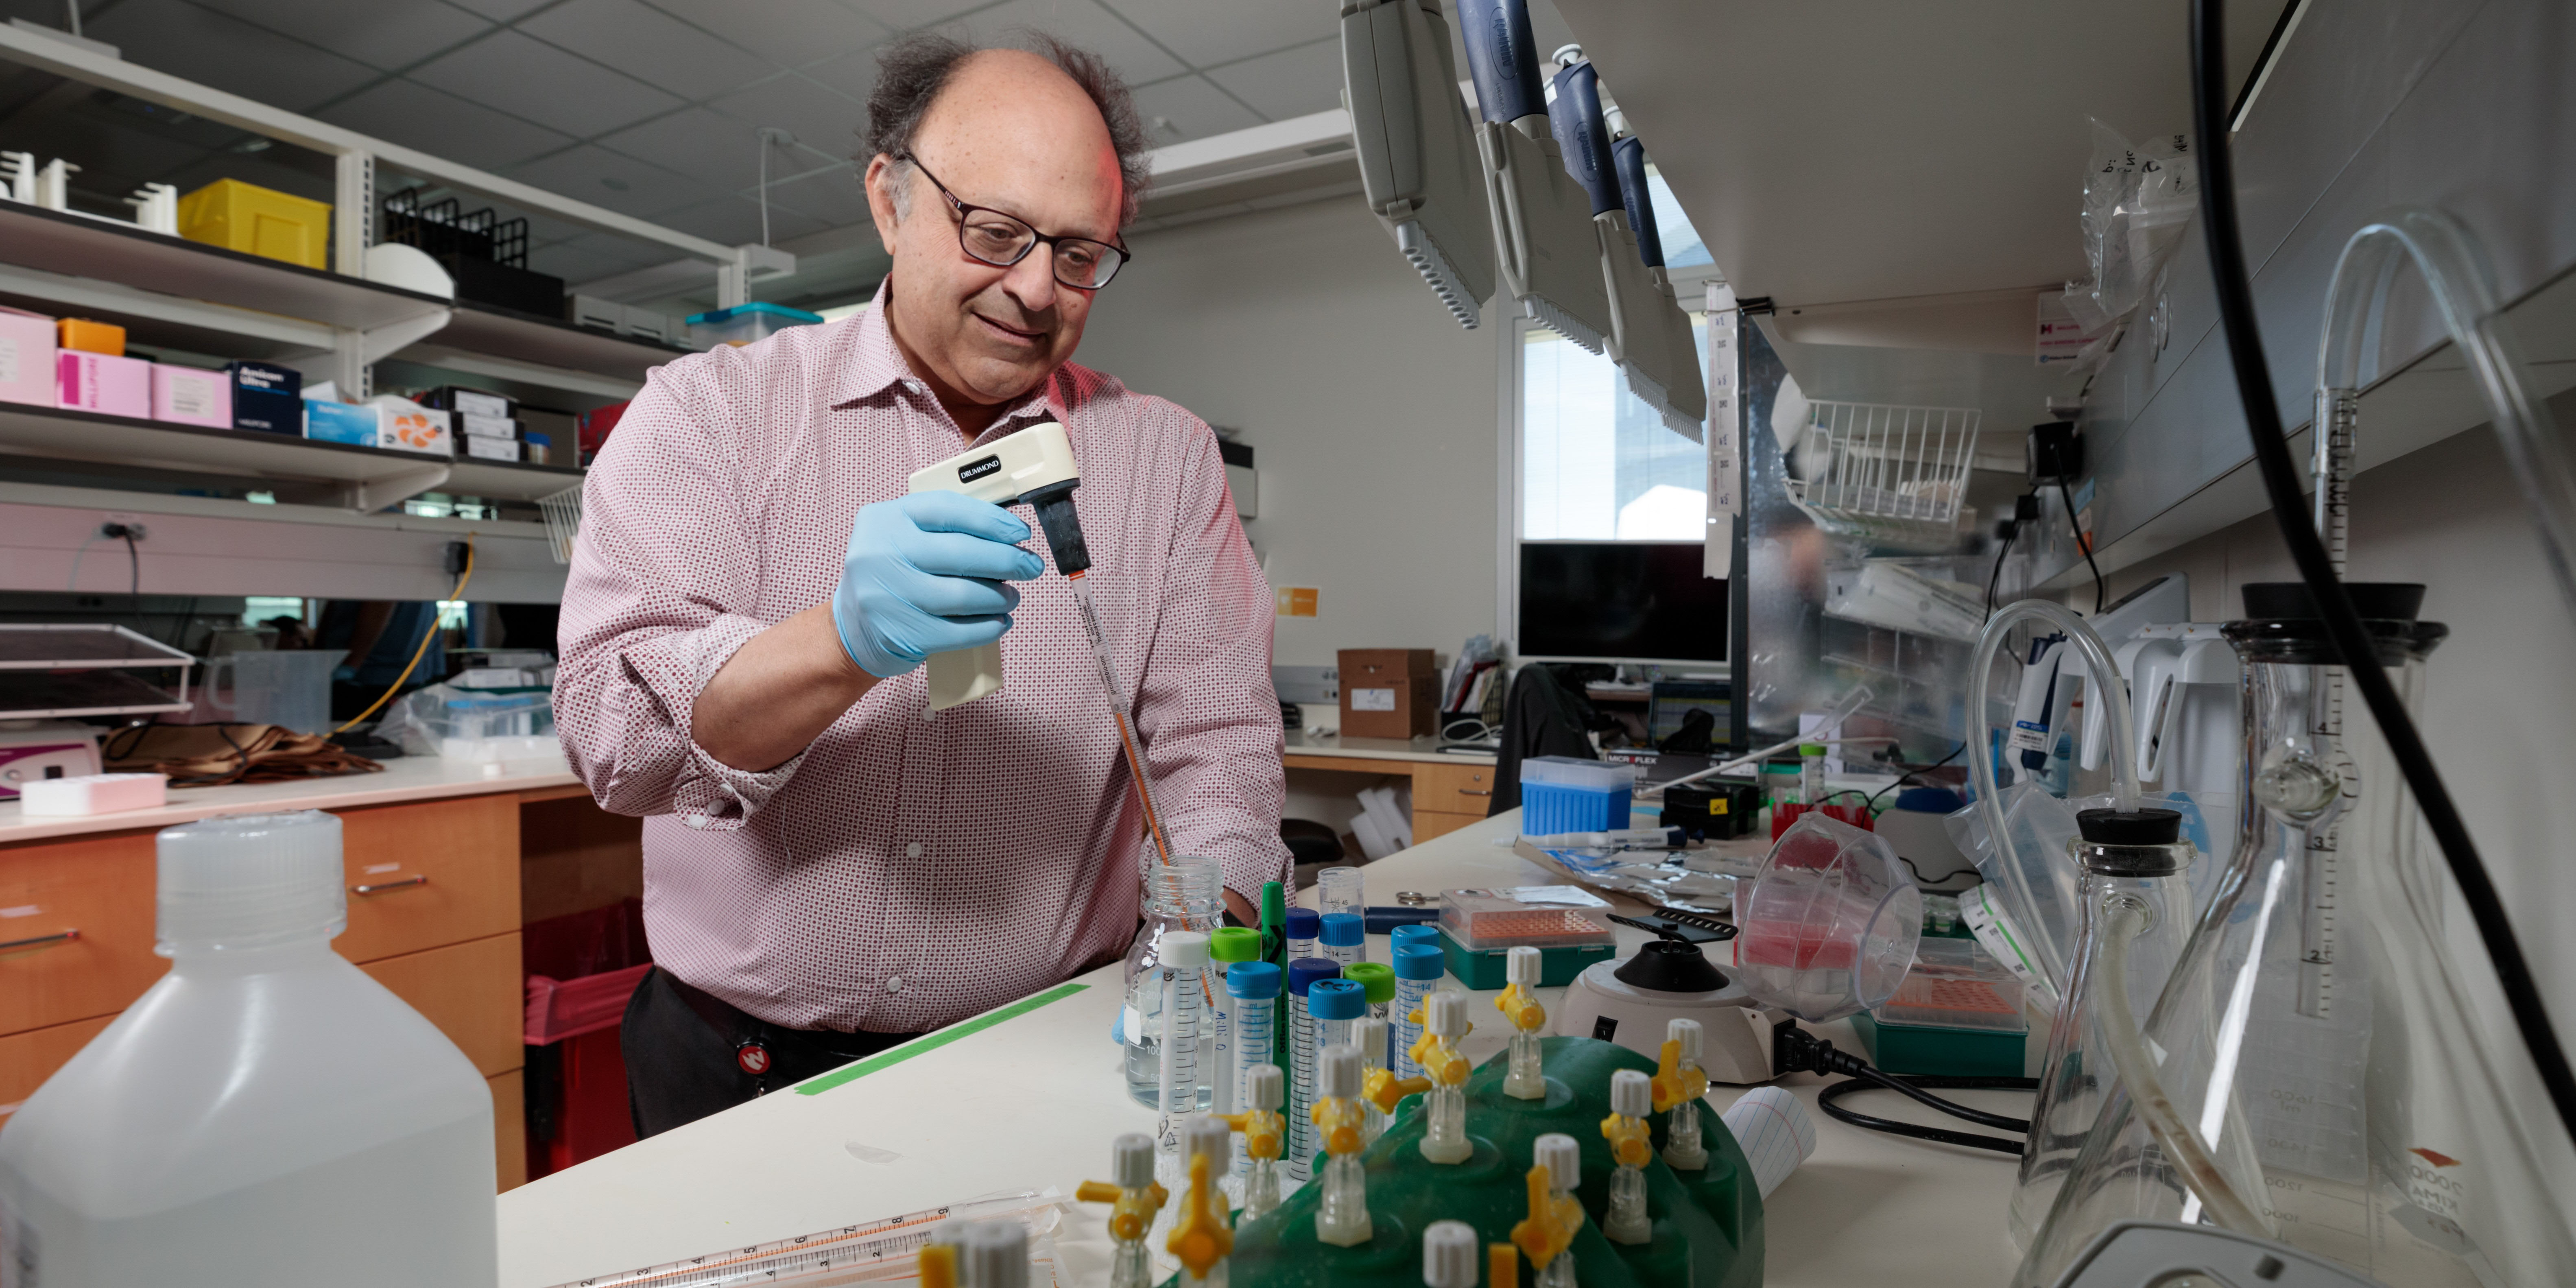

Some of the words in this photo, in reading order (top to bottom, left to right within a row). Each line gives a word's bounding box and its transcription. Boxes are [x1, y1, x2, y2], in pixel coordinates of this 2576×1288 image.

[1493, 18, 1515, 67] RAININ
[1577, 131, 1597, 171] RAININ
[239, 366, 284, 382] Amicon
[239, 375, 271, 389] Ultra
[961, 460, 999, 479] DRUMMOND
[1099, 655, 1109, 675] bio-one
[1105, 675, 1116, 695] greiner
[2318, 722, 2327, 732] 4
[2314, 836, 2323, 847] 3
[2311, 950, 2319, 959] 2
[1146, 990, 1161, 1001] 200
[1146, 1045, 1160, 1055] 100
[1419, 1068, 1425, 1076] 8
